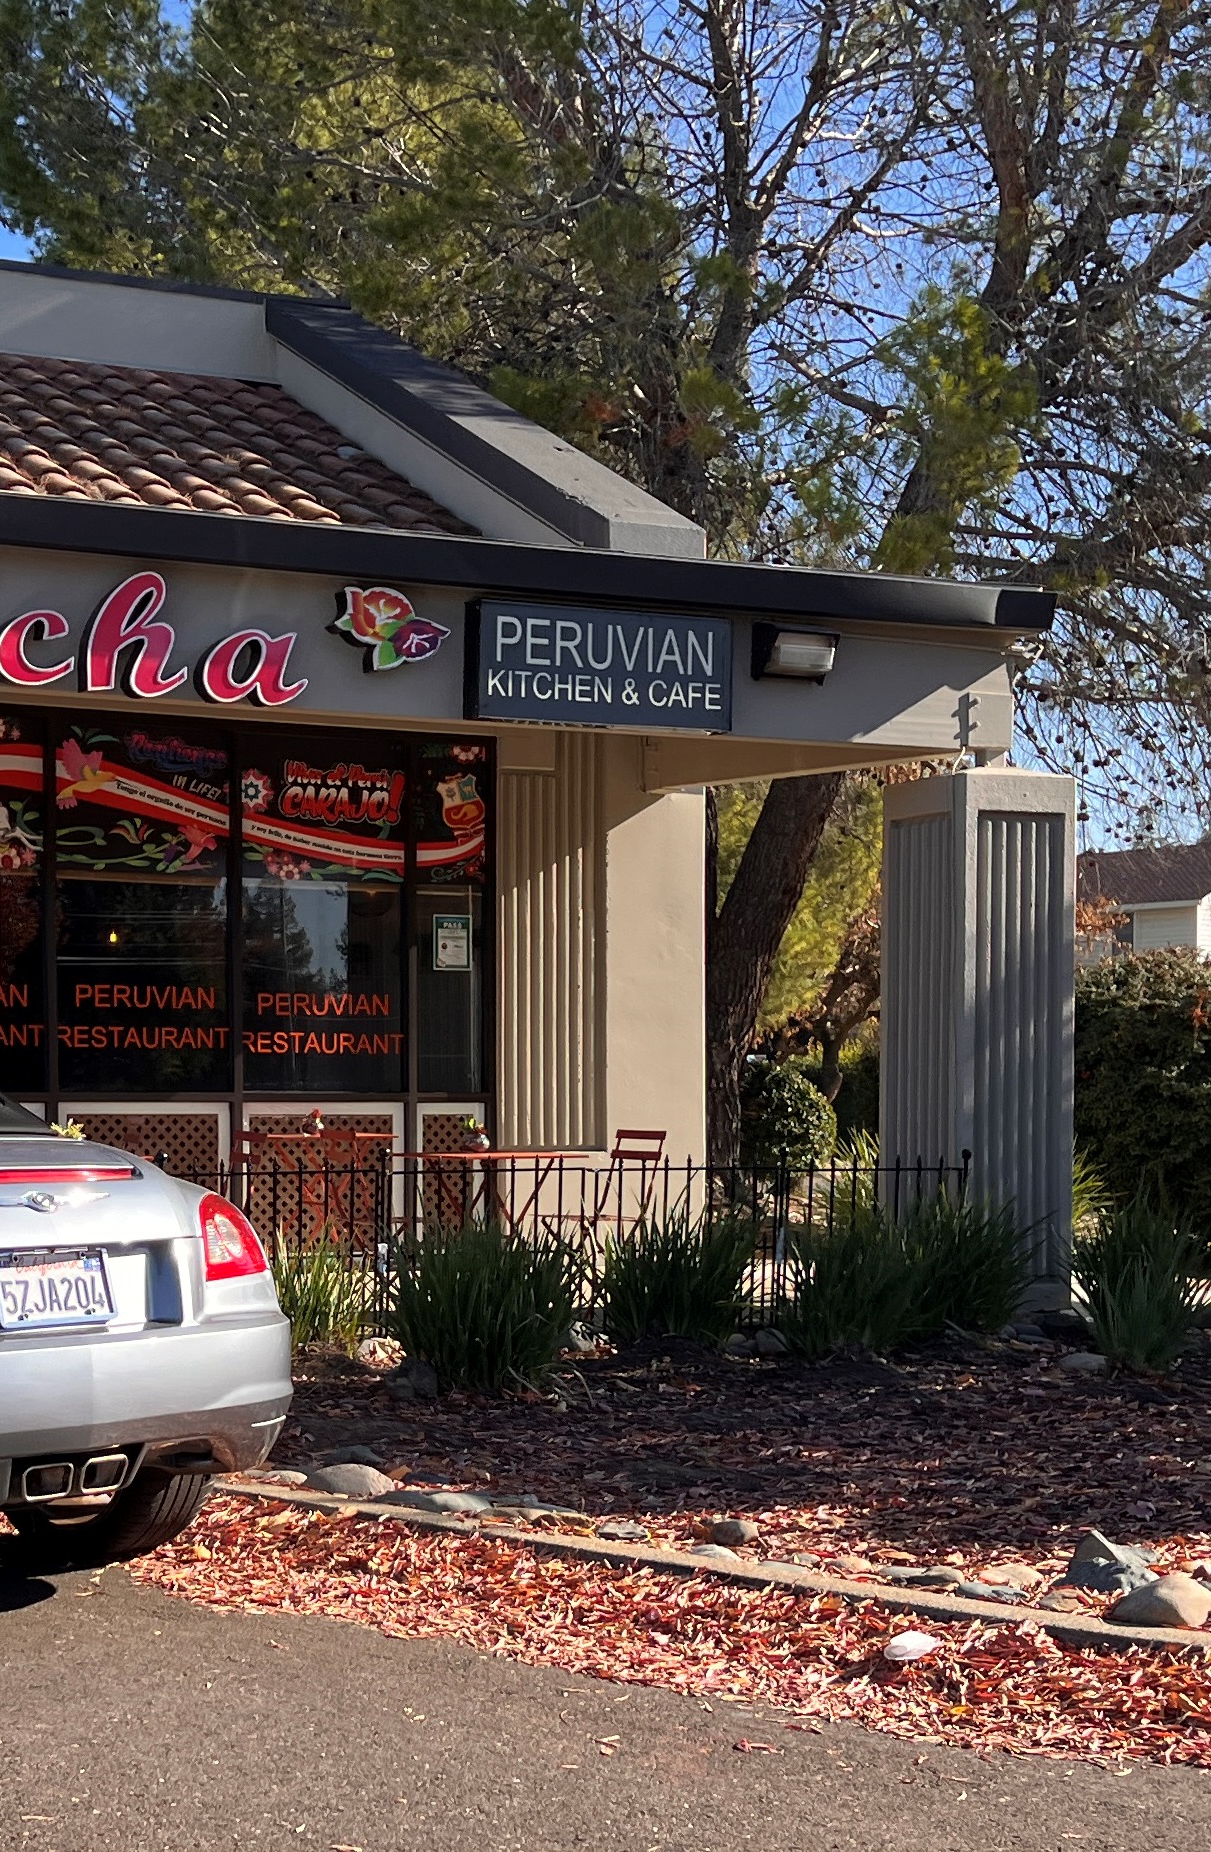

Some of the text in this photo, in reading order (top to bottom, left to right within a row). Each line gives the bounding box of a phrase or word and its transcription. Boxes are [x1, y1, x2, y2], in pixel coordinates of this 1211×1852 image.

[496, 615, 713, 676] PERUVIAN
[487, 669, 721, 710] KITCHEN & CAFE
[172, 774, 188, 790] IN
[281, 770, 406, 825] CARAJO!
[74, 983, 216, 1010] PERUVIAN
[257, 992, 391, 1017] PERUVIAN
[57, 1025, 231, 1049] RESTAURANT
[241, 1031, 405, 1055] RESTAURANT
[0, 1275, 106, 1315] 5ZJA204
